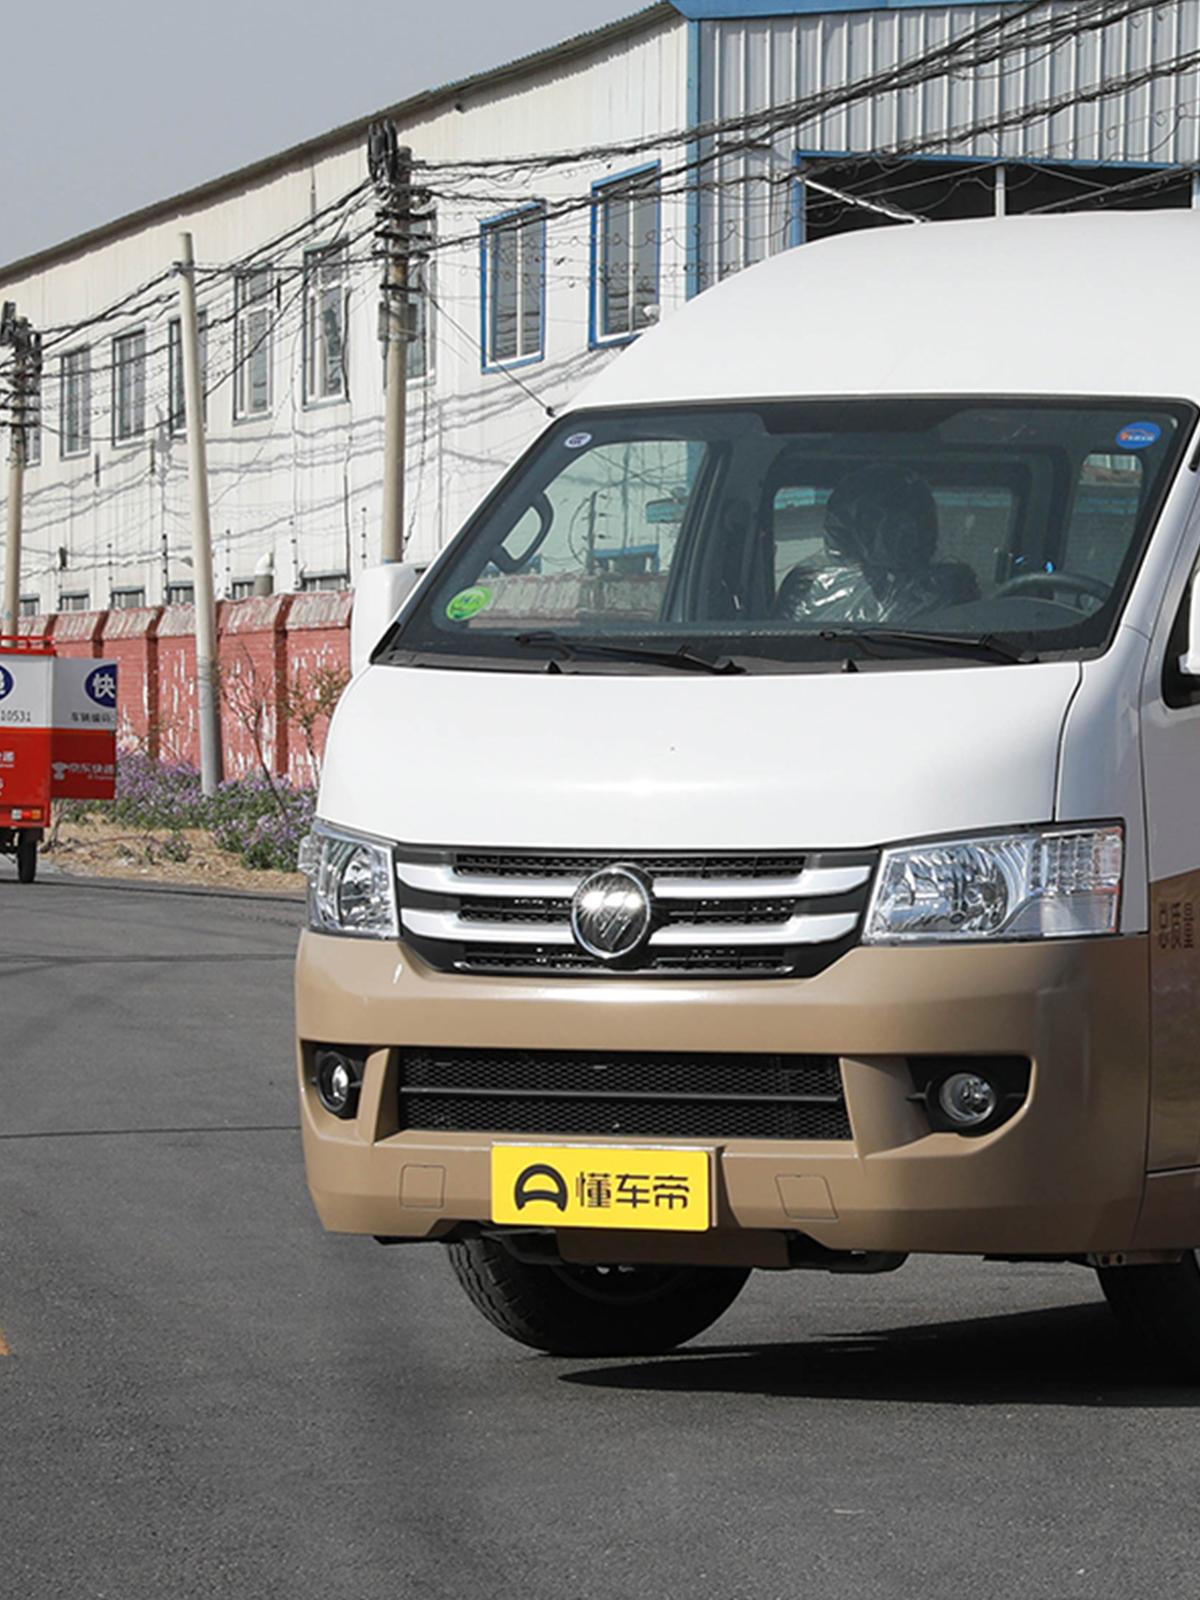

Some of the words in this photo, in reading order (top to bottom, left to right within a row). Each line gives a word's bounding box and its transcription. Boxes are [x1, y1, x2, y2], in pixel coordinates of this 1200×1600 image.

[93, 673, 115, 698] 快
[576, 1171, 690, 1210] 懂车帝
